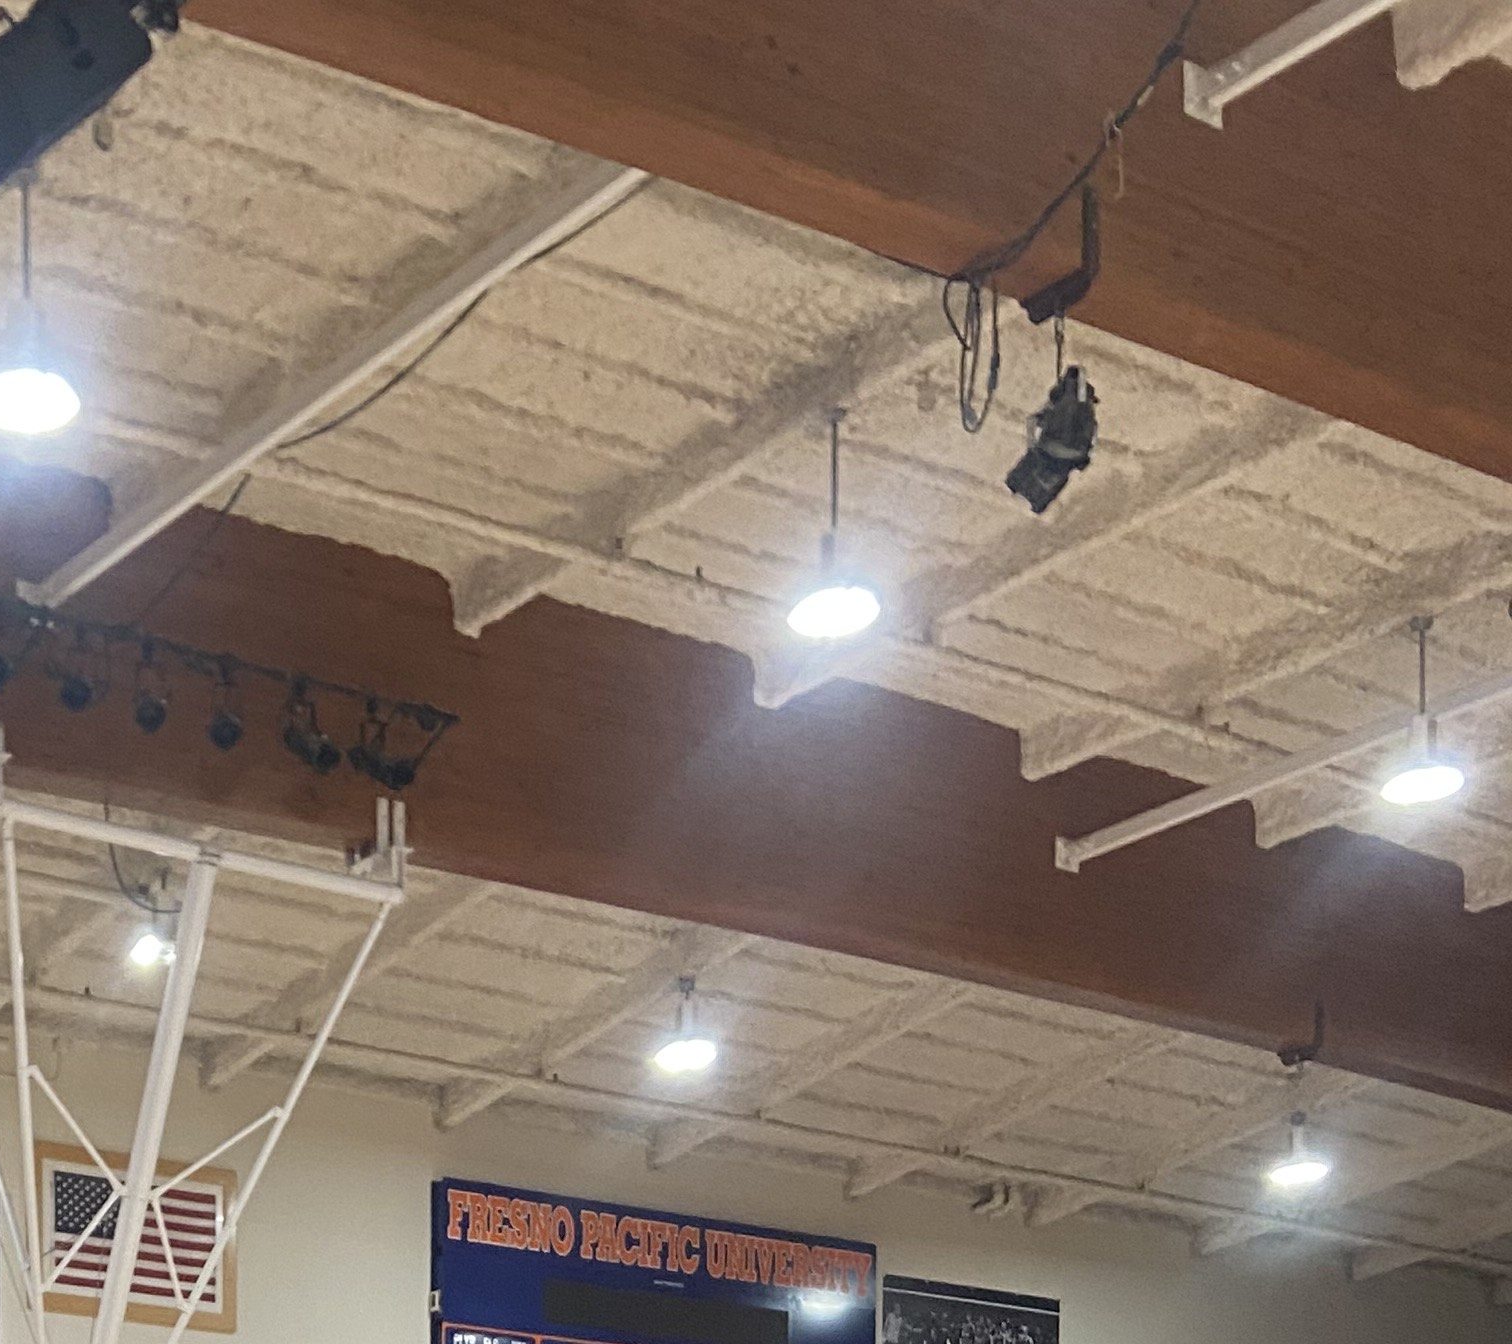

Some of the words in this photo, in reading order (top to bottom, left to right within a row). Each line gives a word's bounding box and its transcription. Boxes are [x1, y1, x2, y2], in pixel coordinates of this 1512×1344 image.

[447, 1188, 575, 1257] FRESNO
[580, 1209, 700, 1275] PACIFIC
[705, 1229, 872, 1297] UNIVERSITY
